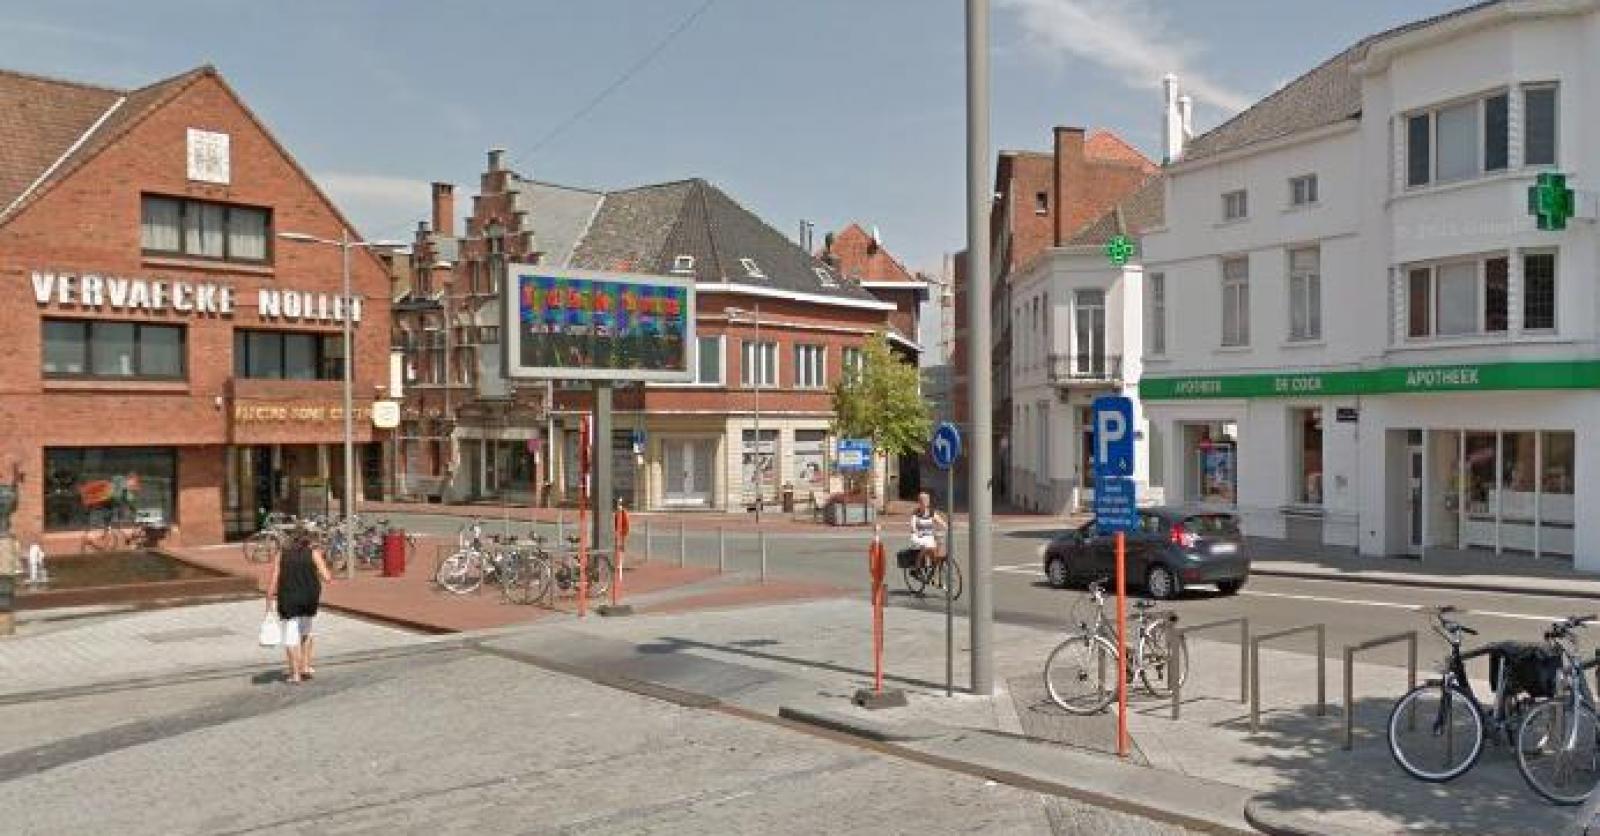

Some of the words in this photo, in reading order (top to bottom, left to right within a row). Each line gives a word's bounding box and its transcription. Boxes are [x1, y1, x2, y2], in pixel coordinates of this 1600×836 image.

[31, 270, 236, 315] VERVAECKE
[1407, 368, 1481, 386] APOTHEEK
[1097, 410, 1127, 464] P
